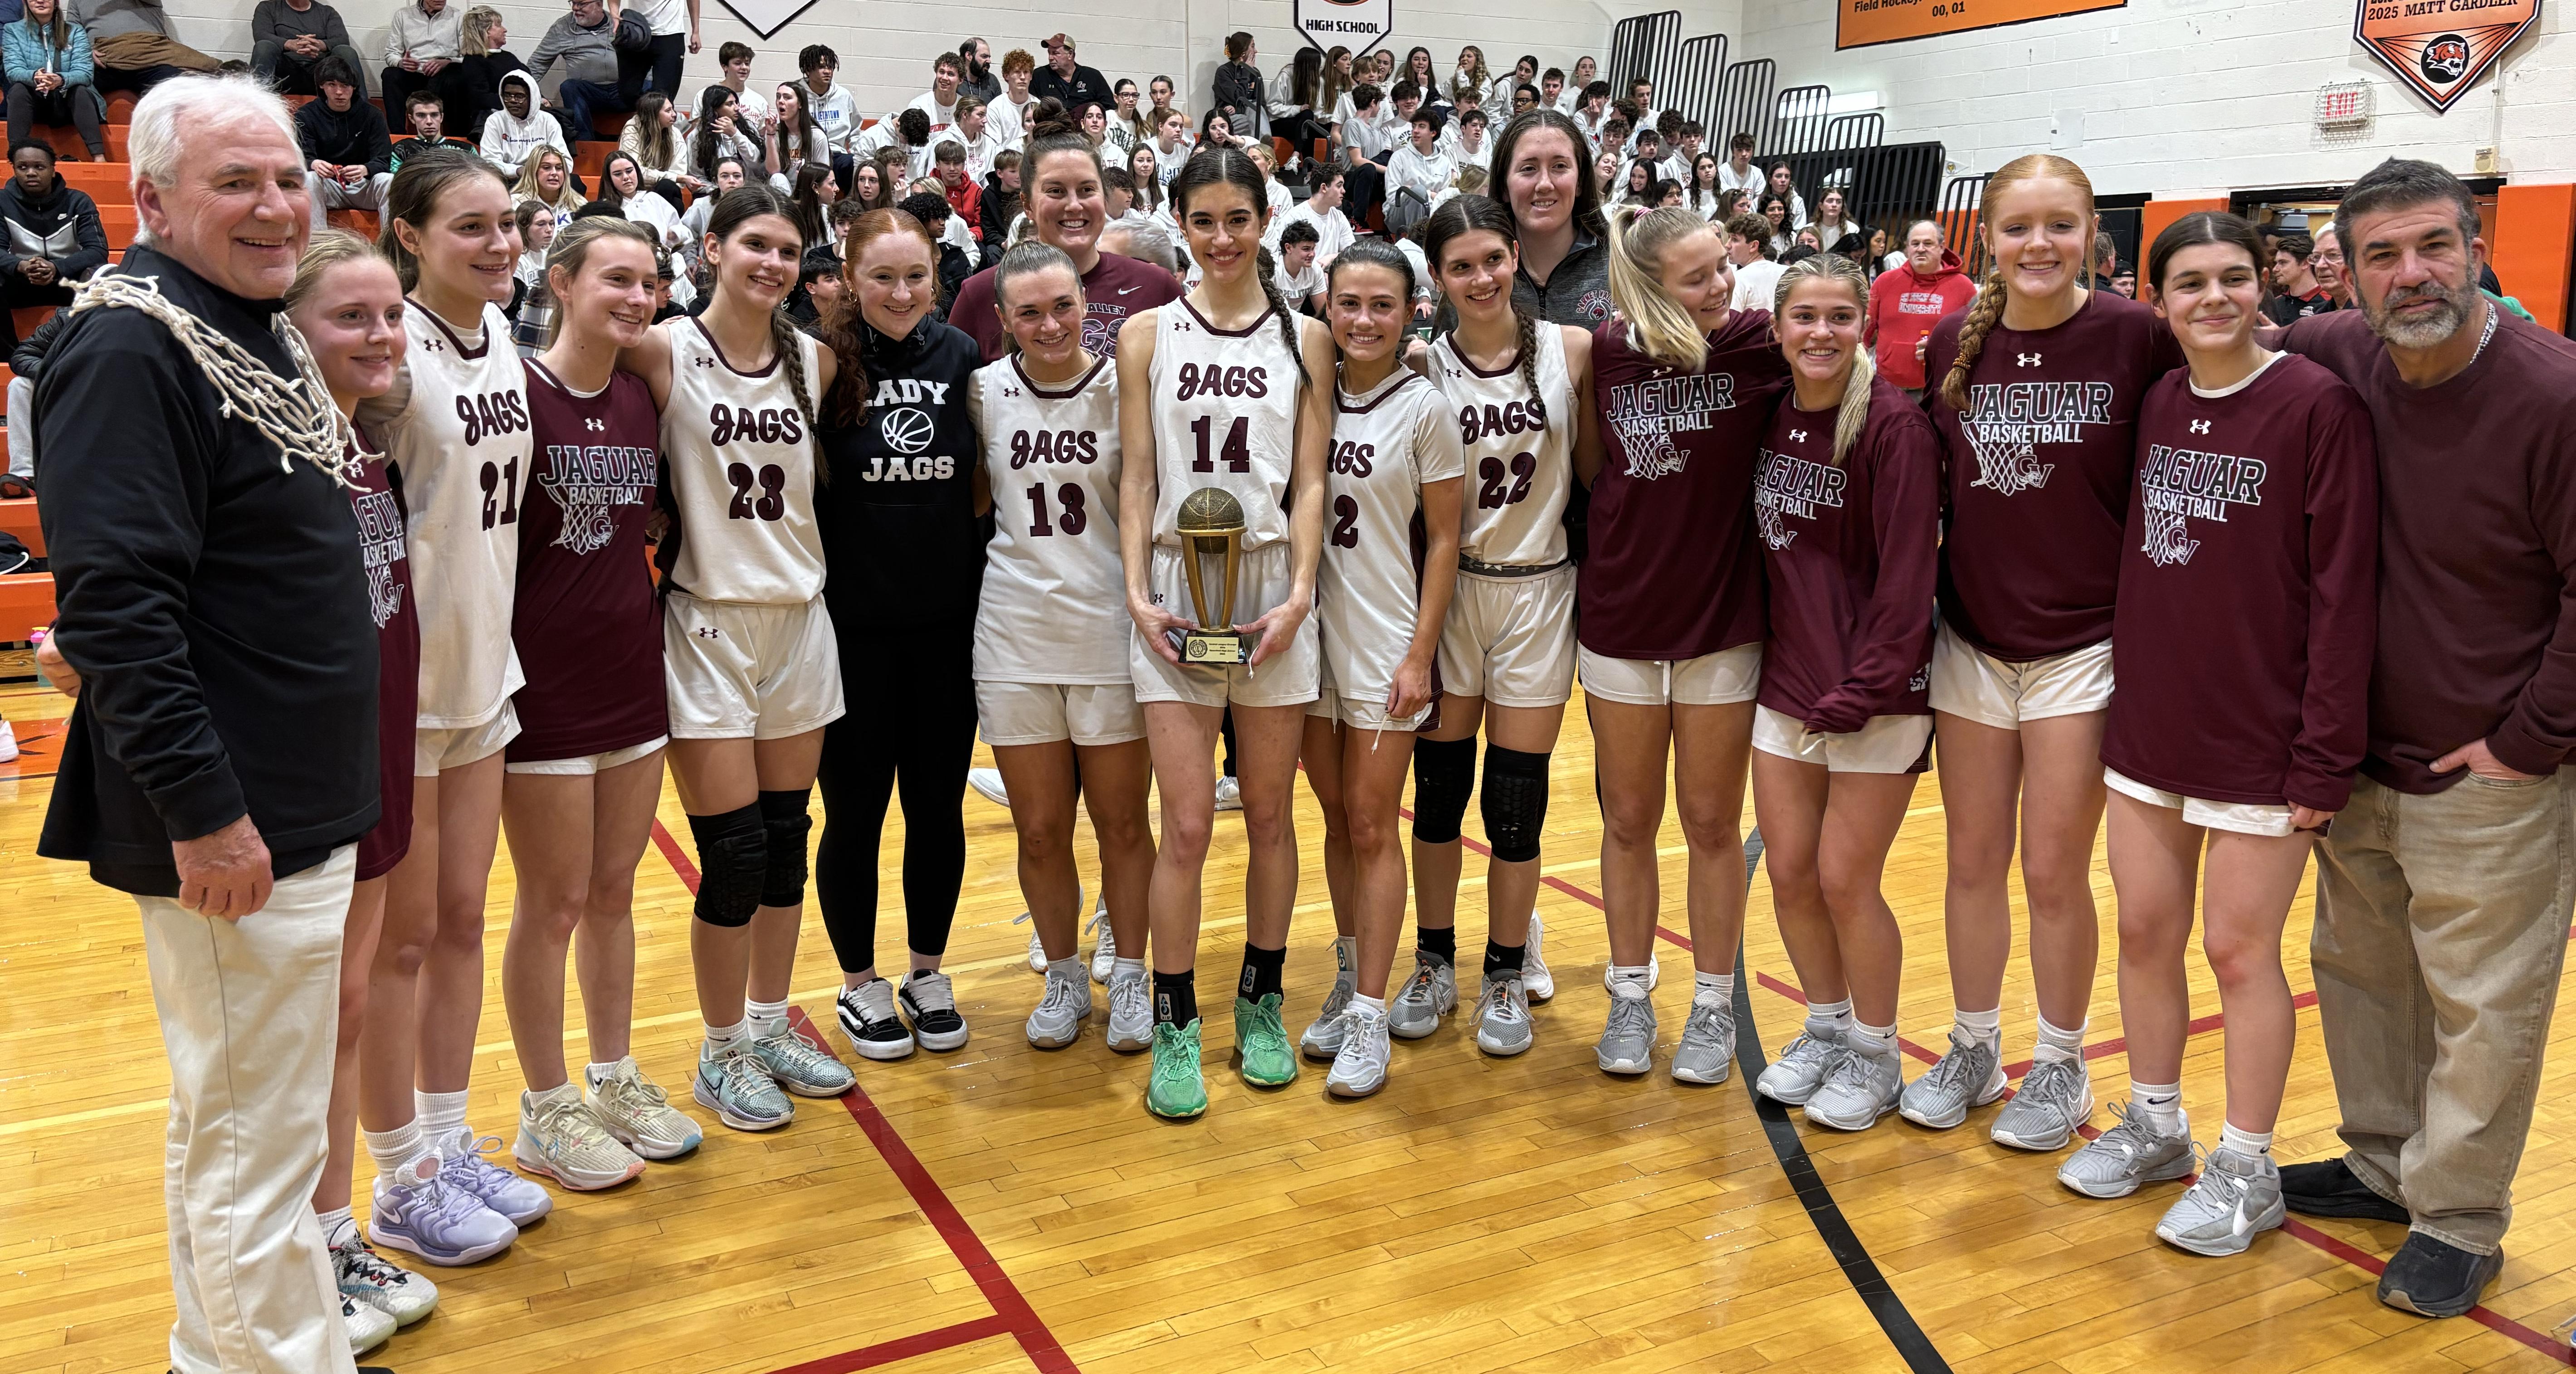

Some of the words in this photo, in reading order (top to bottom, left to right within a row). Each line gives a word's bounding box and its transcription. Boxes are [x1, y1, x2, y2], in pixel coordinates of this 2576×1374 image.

[1854, 0, 1878, 13] Field
[1932, 5, 1948, 17] 00,
[1952, 1, 1965, 13] 01
[2368, 6, 2398, 20] 2025
[2404, 0, 2445, 16] MATT
[1306, 19, 1333, 31] HIGH
[1336, 21, 1381, 34] SCHOOL
[2326, 92, 2358, 116] EXIT
[1086, 303, 1126, 315] ALLEY
[1576, 290, 1597, 313] GARNET
[863, 379, 950, 407] ADY
[1177, 363, 1268, 401] JAGS
[1606, 373, 1736, 422] JAGUAR
[456, 390, 529, 446] JAGS
[1959, 382, 2113, 424] JAGUAR
[711, 403, 802, 446] JAGS
[1459, 401, 1545, 445] JAGS
[1623, 412, 1713, 438] BASKETBALL
[1979, 423, 2083, 443] BASKETBALL
[1010, 430, 1098, 470] JAGS
[1191, 415, 1249, 473] 14
[537, 445, 657, 487] JAGUAR
[863, 456, 955, 482] JAGS
[1478, 452, 1537, 510] 22
[2141, 444, 2265, 506] JAGUAR
[480, 456, 518, 531] 21
[569, 487, 644, 505] BASKETBALL
[728, 462, 785, 521] 23
[1027, 482, 1087, 536] 13
[1756, 487, 1816, 520] BASKETBALL
[2147, 489, 2228, 522] BASKETBALL
[1331, 494, 1358, 549] 2
